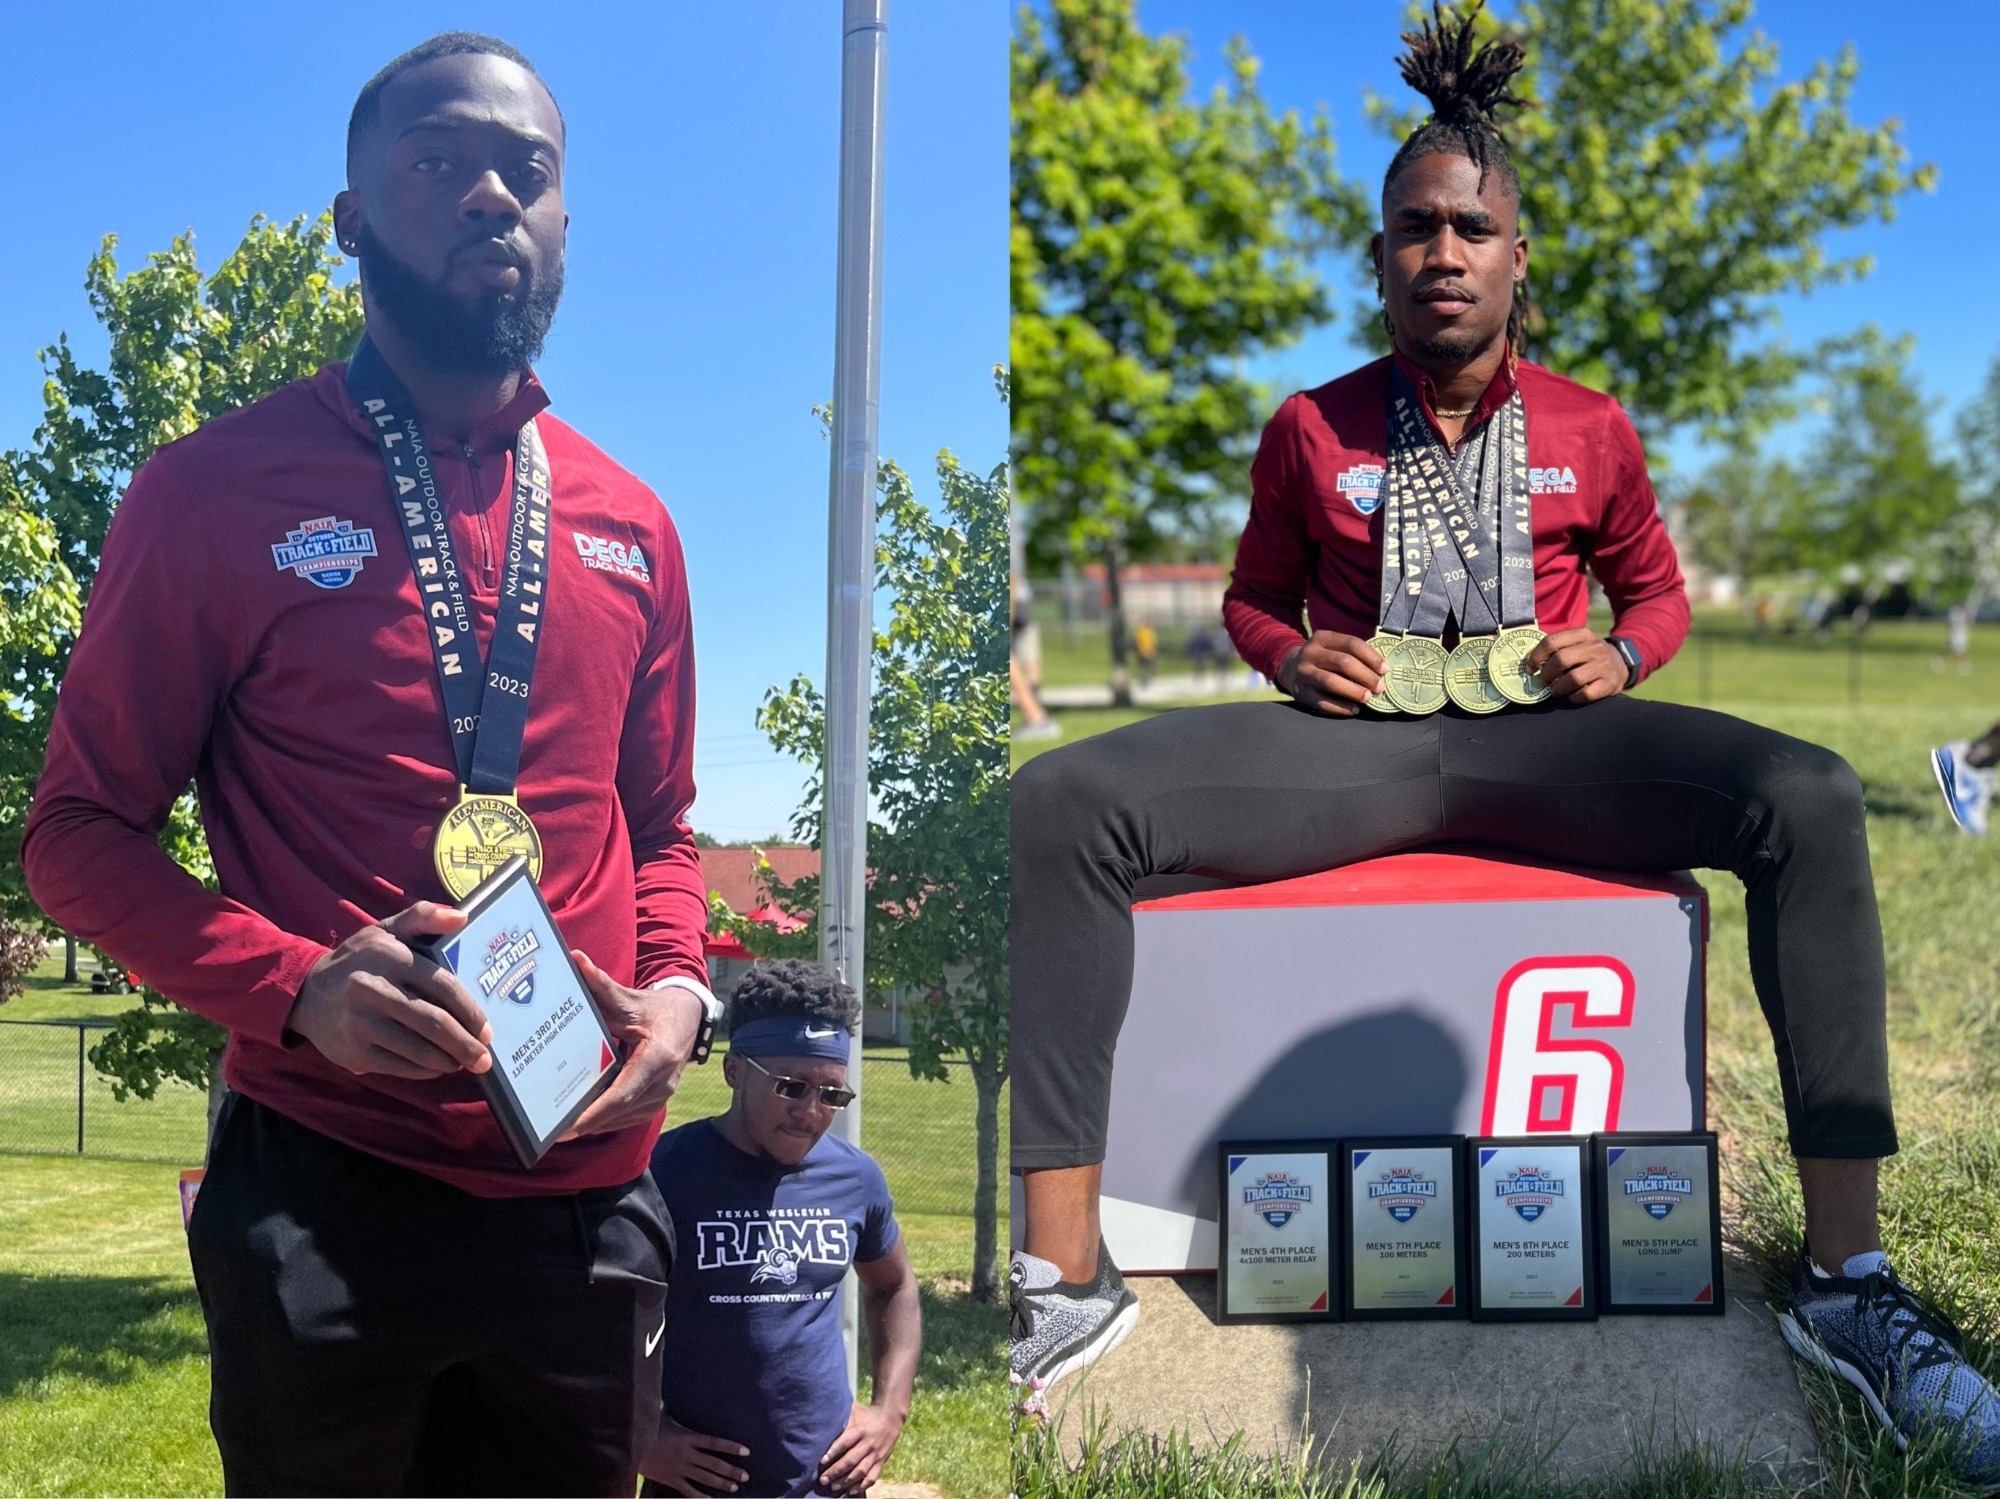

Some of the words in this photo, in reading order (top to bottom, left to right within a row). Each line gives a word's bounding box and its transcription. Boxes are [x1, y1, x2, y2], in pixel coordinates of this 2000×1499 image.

[1413, 407, 1425, 431] NAIA
[404, 419, 423, 454] NAIA
[520, 445, 529, 455] &
[1423, 428, 1450, 473] OUTDOOR
[518, 456, 530, 494] TRACK
[1463, 461, 1475, 482] NAIA
[1485, 445, 1497, 493] OUTDOOR
[1512, 394, 1529, 535] ALL-AMERIC
[1340, 477, 1369, 488] TRACK
[1394, 397, 1480, 559] ALL-AMERICAN
[1446, 472, 1463, 499] TRACK
[1529, 466, 1577, 487] EGA
[415, 455, 444, 532] OUTDOOR
[1545, 486, 1552, 494] &
[1554, 486, 1576, 494] FIELD
[1458, 497, 1467, 505] &
[1482, 493, 1492, 516] NAIA
[1461, 503, 1478, 529] FIELD
[304, 520, 335, 534] NAIA
[363, 398, 463, 676] ALL-AMERICAN
[510, 493, 526, 562] OUTDOOR
[277, 541, 325, 563] TRACK
[330, 533, 372, 553] FIELD
[435, 532, 458, 580] TRACK
[573, 532, 648, 572] DEGA
[298, 558, 359, 572] CHAMPIONSHIPS
[581, 557, 616, 572] TRACK
[1505, 557, 1532, 569] 2023
[448, 581, 459, 592] &
[506, 564, 520, 597] NAIA
[1444, 569, 1467, 583] 202
[1480, 575, 1500, 591] 202
[451, 593, 470, 632] FIELD
[489, 672, 529, 698] 2023
[454, 714, 481, 734] 202
[489, 932, 509, 954] NAIA
[479, 955, 511, 994] TRACK
[510, 930, 539, 963] FIELD
[511, 1036, 536, 1064] MEN'S
[535, 1020, 552, 1040] 3RD
[550, 996, 575, 1024] PLACE
[511, 1062, 525, 1078] 110
[523, 1043, 545, 1067] METER
[544, 1028, 559, 1046] HIGH
[558, 1002, 584, 1032] HURDLES
[1480, 955, 1636, 1138] 6
[1245, 1188, 1277, 1201] TRACK
[1282, 1188, 1310, 1200] FIELD
[1369, 1183, 1402, 1197] TRACK
[1407, 1182, 1435, 1195] FIELD
[1497, 1181, 1530, 1195] TRACK
[1534, 1180, 1562, 1194] FIELD
[1625, 1180, 1658, 1193] TRACK
[1663, 1179, 1691, 1192] FIELD
[716, 1209, 760, 1218] TEXAS
[766, 1208, 831, 1218] WESLEYAN
[697, 1219, 849, 1270] RAMS
[1270, 1247, 1286, 1255] 4TH
[1288, 1246, 1316, 1255] PLACE
[1414, 1241, 1441, 1249] PLACE
[1523, 1241, 1539, 1249] 8TH
[1542, 1241, 1569, 1249] PLACE
[1623, 1239, 1649, 1247] MEN'S
[1239, 1256, 1263, 1264] 4x100
[1293, 1255, 1317, 1263] RELAY
[1380, 1251, 1394, 1259] 100
[1524, 1250, 1556, 1258] METERS
[709, 1295, 741, 1304] CROSS
[743, 1293, 814, 1304] COUNTRY/TRACK
